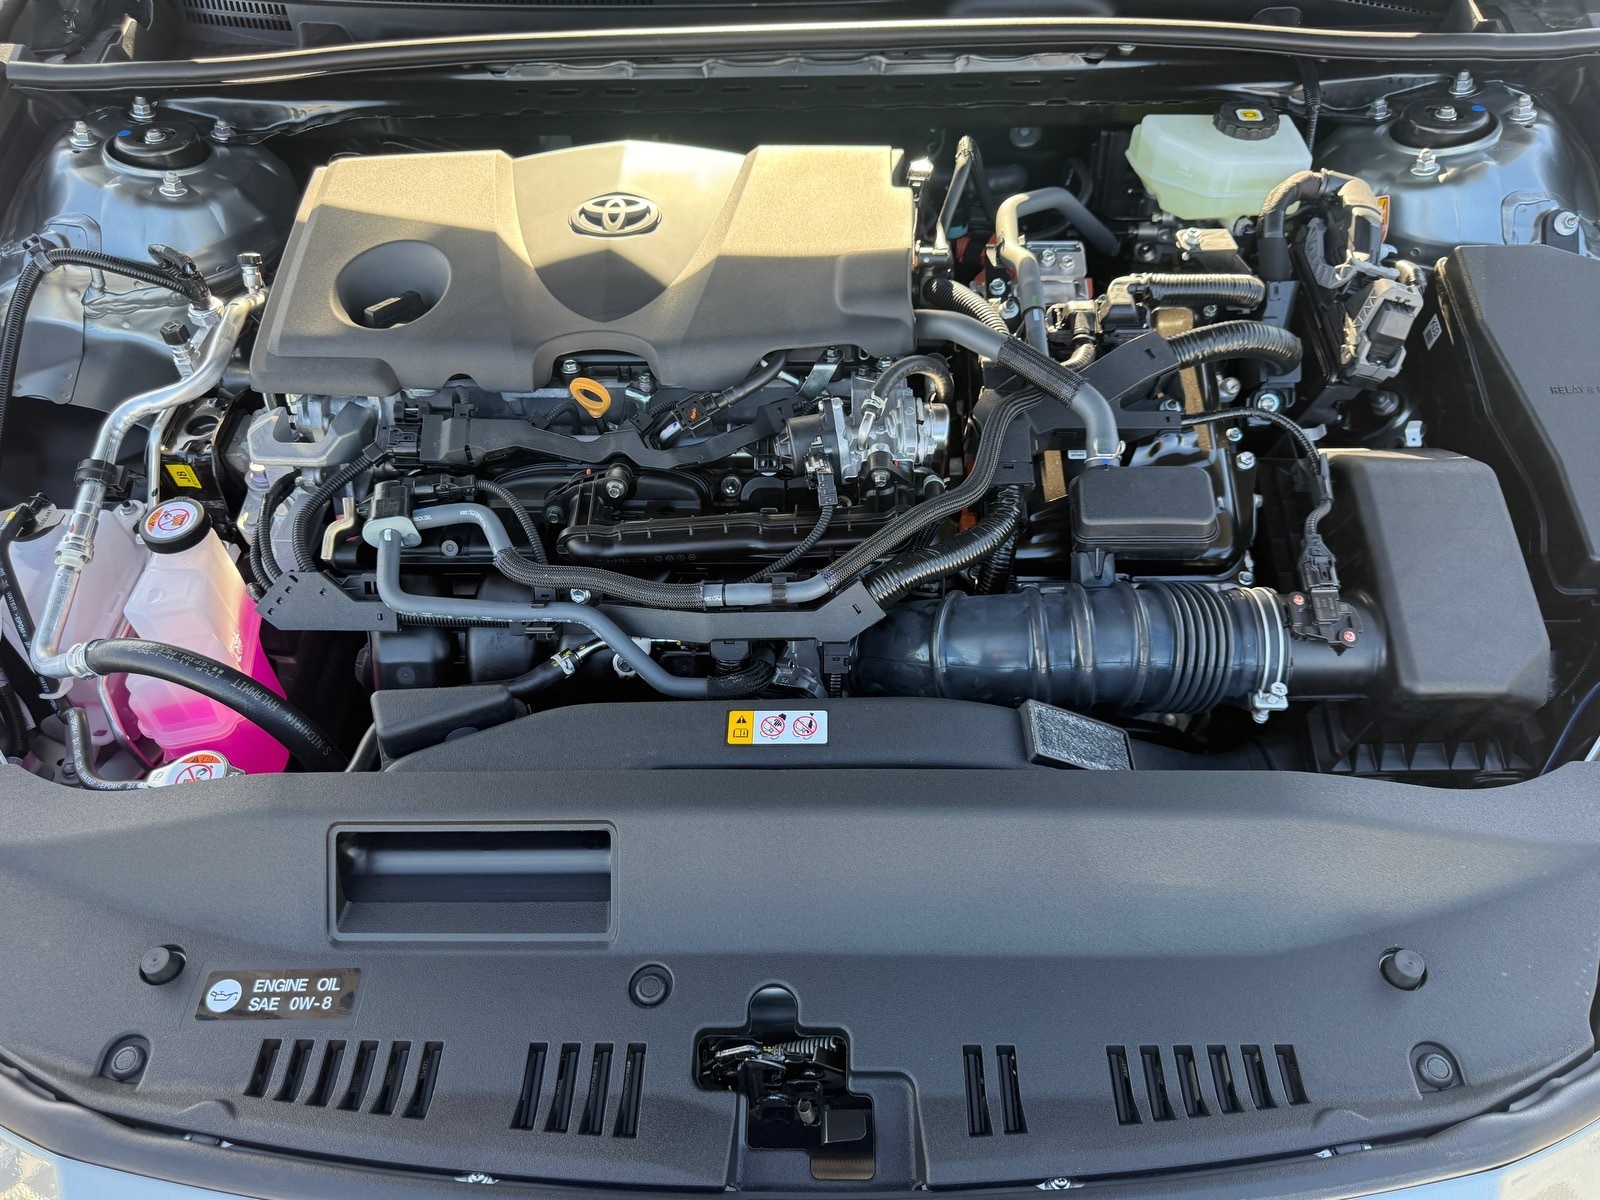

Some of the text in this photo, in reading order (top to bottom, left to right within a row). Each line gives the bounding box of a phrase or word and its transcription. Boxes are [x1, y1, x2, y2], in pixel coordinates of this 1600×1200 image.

[1549, 386, 1584, 395] RELAY
[253, 977, 341, 993] ENGINE OIL
[248, 996, 333, 1011] SAE 0W-8
